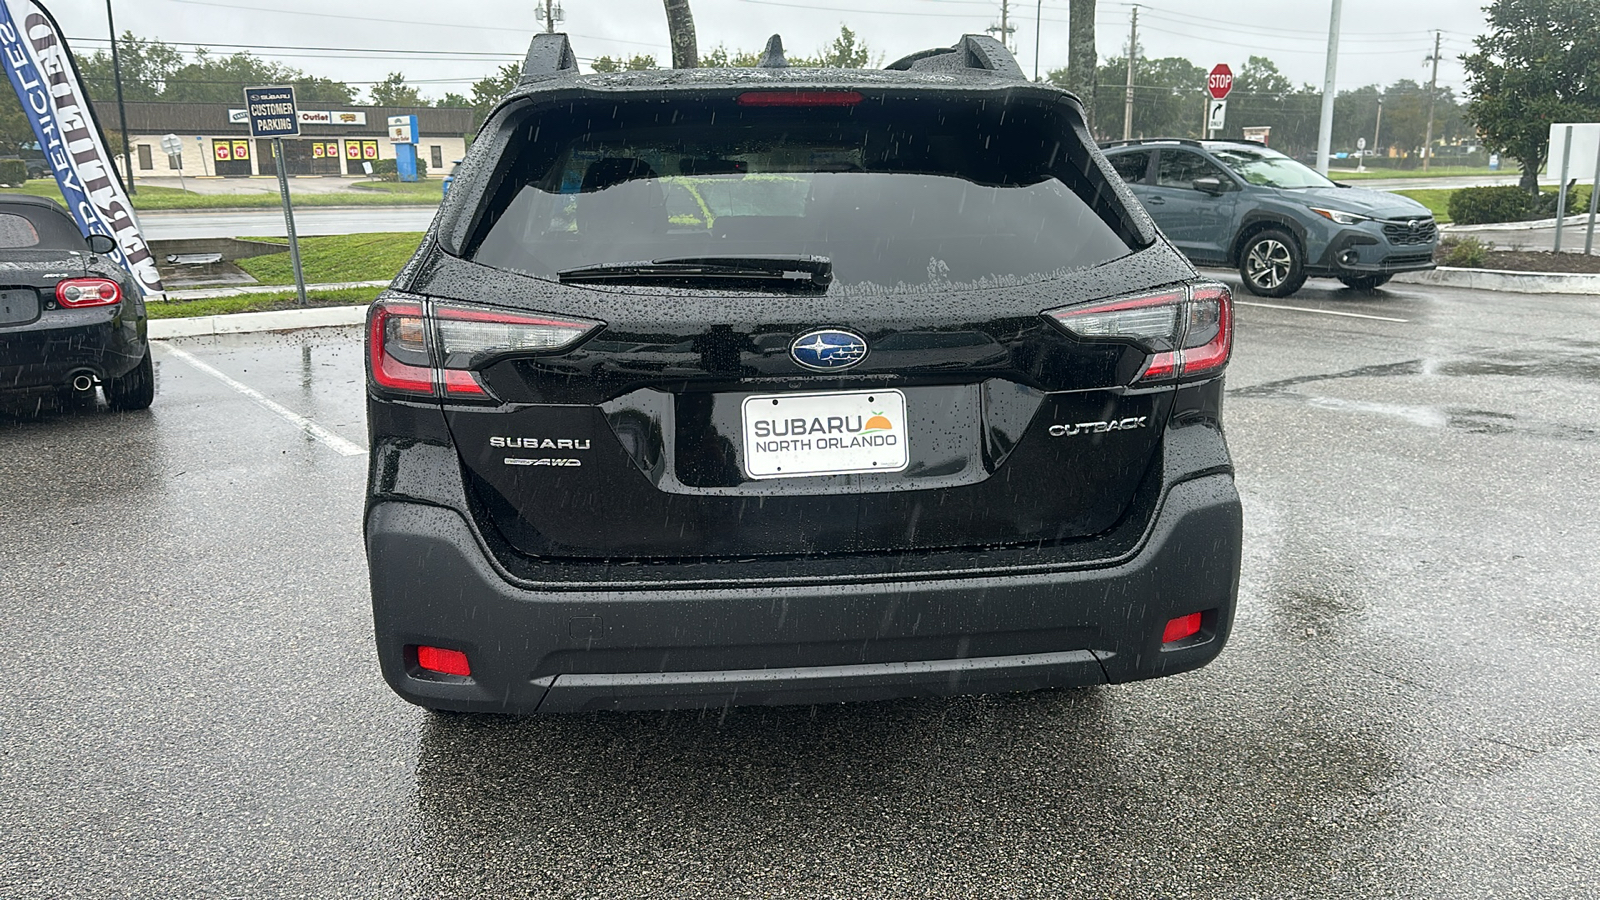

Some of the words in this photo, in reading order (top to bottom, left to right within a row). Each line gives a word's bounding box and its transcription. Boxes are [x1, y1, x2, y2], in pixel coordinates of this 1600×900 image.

[1209, 74, 1231, 89] STOP
[251, 102, 293, 117] CUSTOMER
[302, 113, 329, 121] Outlet
[257, 117, 292, 131] PARKING
[754, 415, 862, 438] SUBARU
[1049, 416, 1147, 437] OUTBACK
[489, 436, 591, 450] SUBARU
[756, 439, 812, 453] NORTH
[816, 434, 897, 449] ORLANDO
[533, 458, 582, 467] AWD
